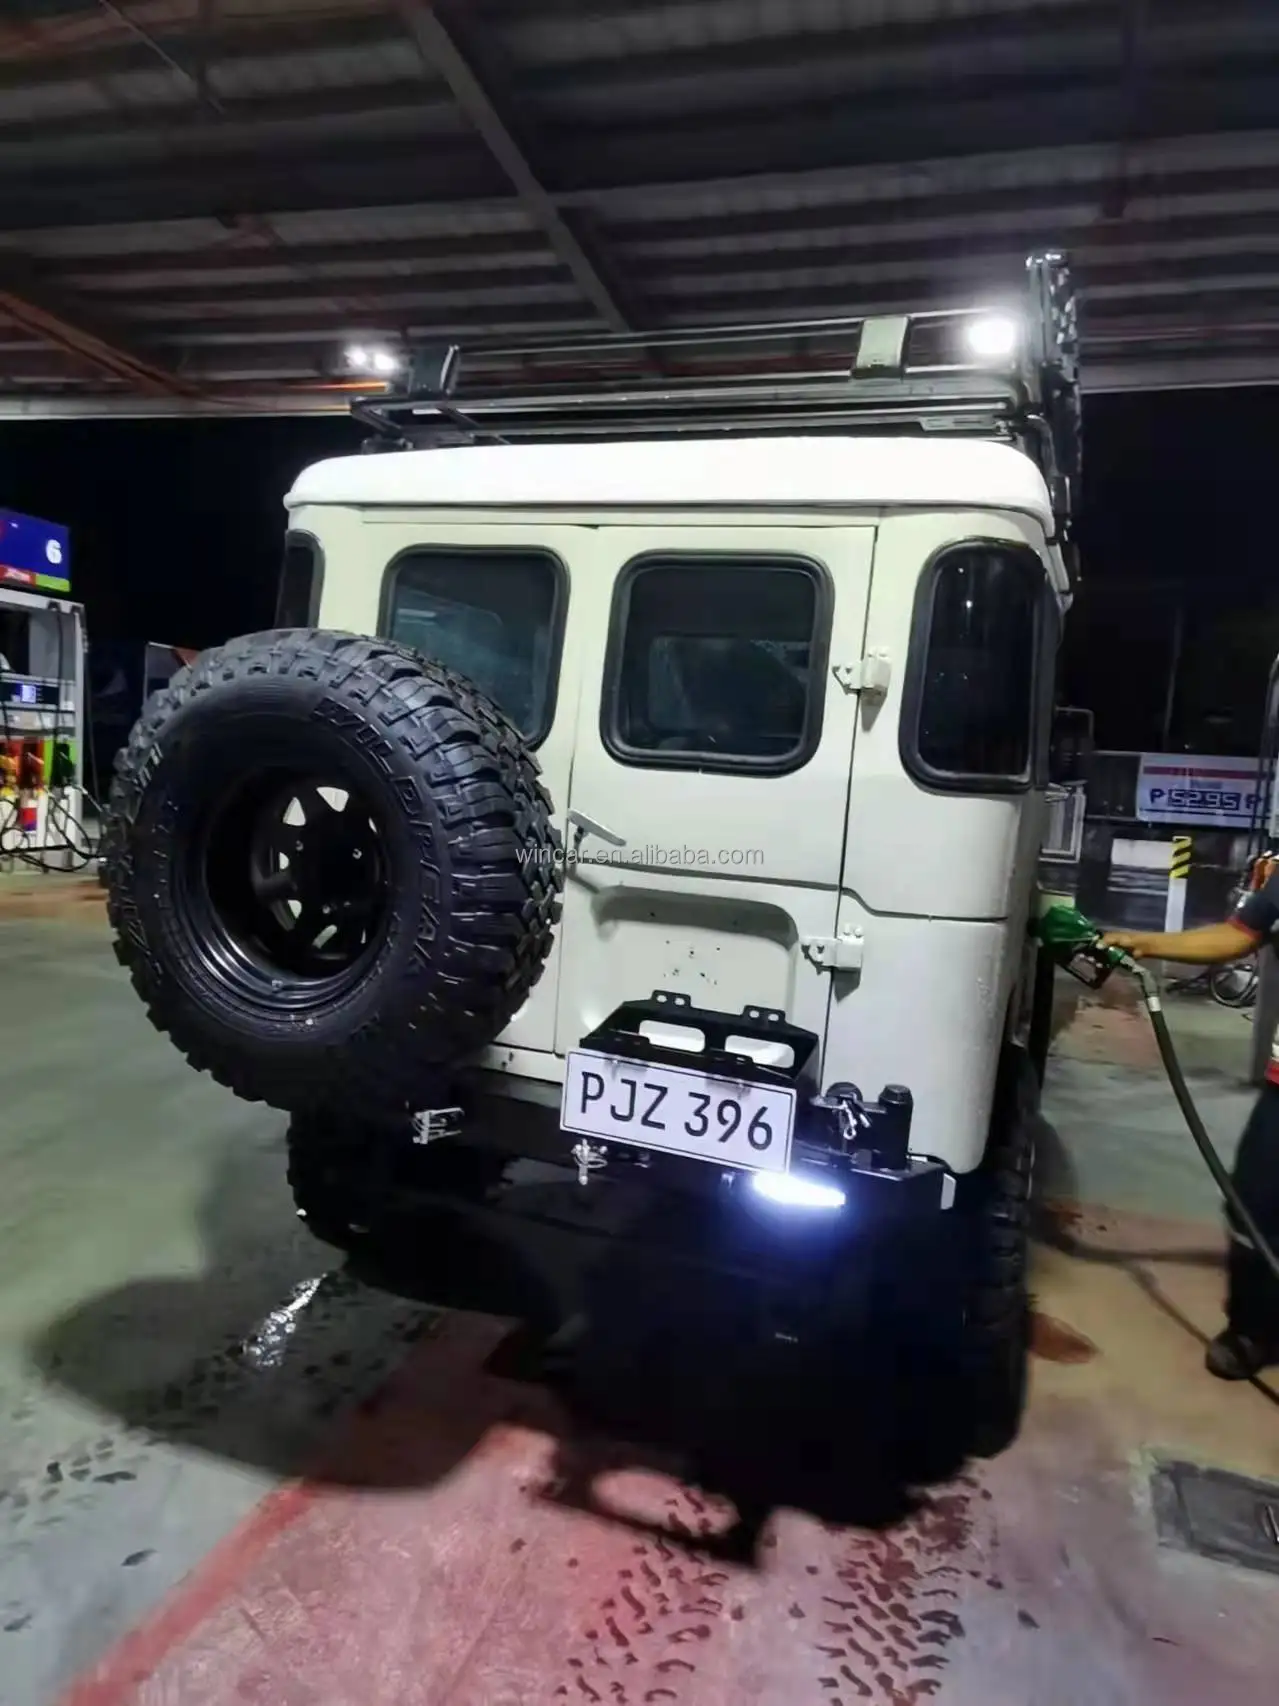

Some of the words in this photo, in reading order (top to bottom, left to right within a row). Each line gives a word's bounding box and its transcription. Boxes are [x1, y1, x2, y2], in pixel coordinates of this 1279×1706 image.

[45, 538, 63, 564] 6
[580, 1071, 670, 1131] PJZ
[684, 1092, 773, 1151] 396
